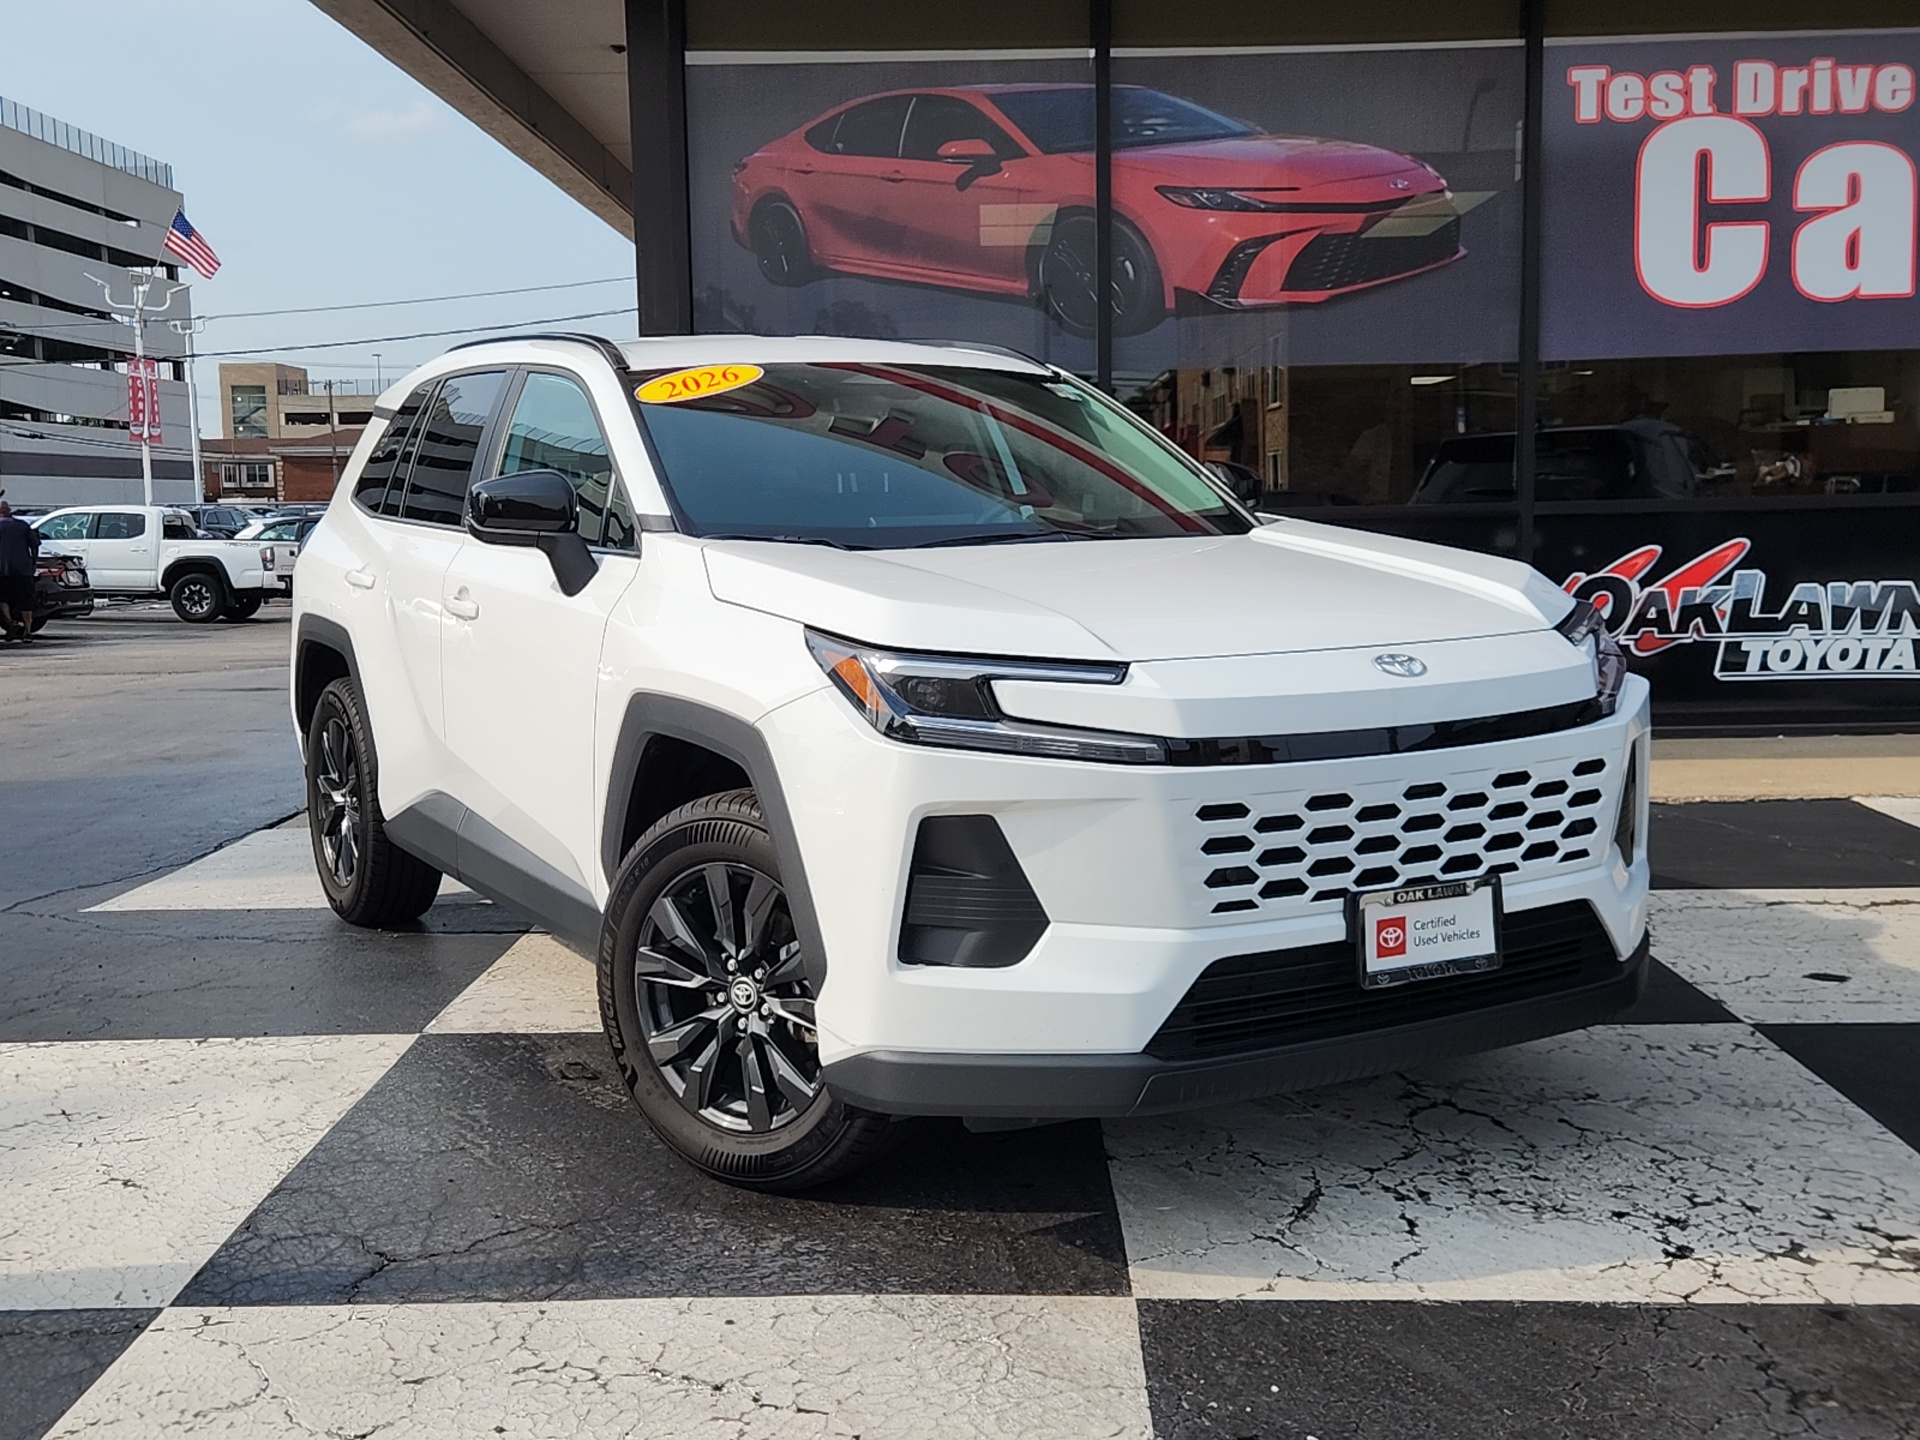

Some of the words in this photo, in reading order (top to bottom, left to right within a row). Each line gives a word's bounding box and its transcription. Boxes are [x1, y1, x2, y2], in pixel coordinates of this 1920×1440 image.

[1568, 65, 1717, 123] Test
[1733, 57, 1917, 116] Drive
[1634, 112, 1917, 309] Ca
[660, 367, 740, 399] 2026
[1741, 638, 1917, 671] TOYOTA
[1396, 888, 1426, 903] OAK
[1427, 883, 1465, 899] LAWN
[1413, 914, 1456, 930] Certified
[1413, 932, 1439, 947] Used
[1440, 928, 1481, 943] Vehicles
[601, 933, 623, 1049] MICHELIN
